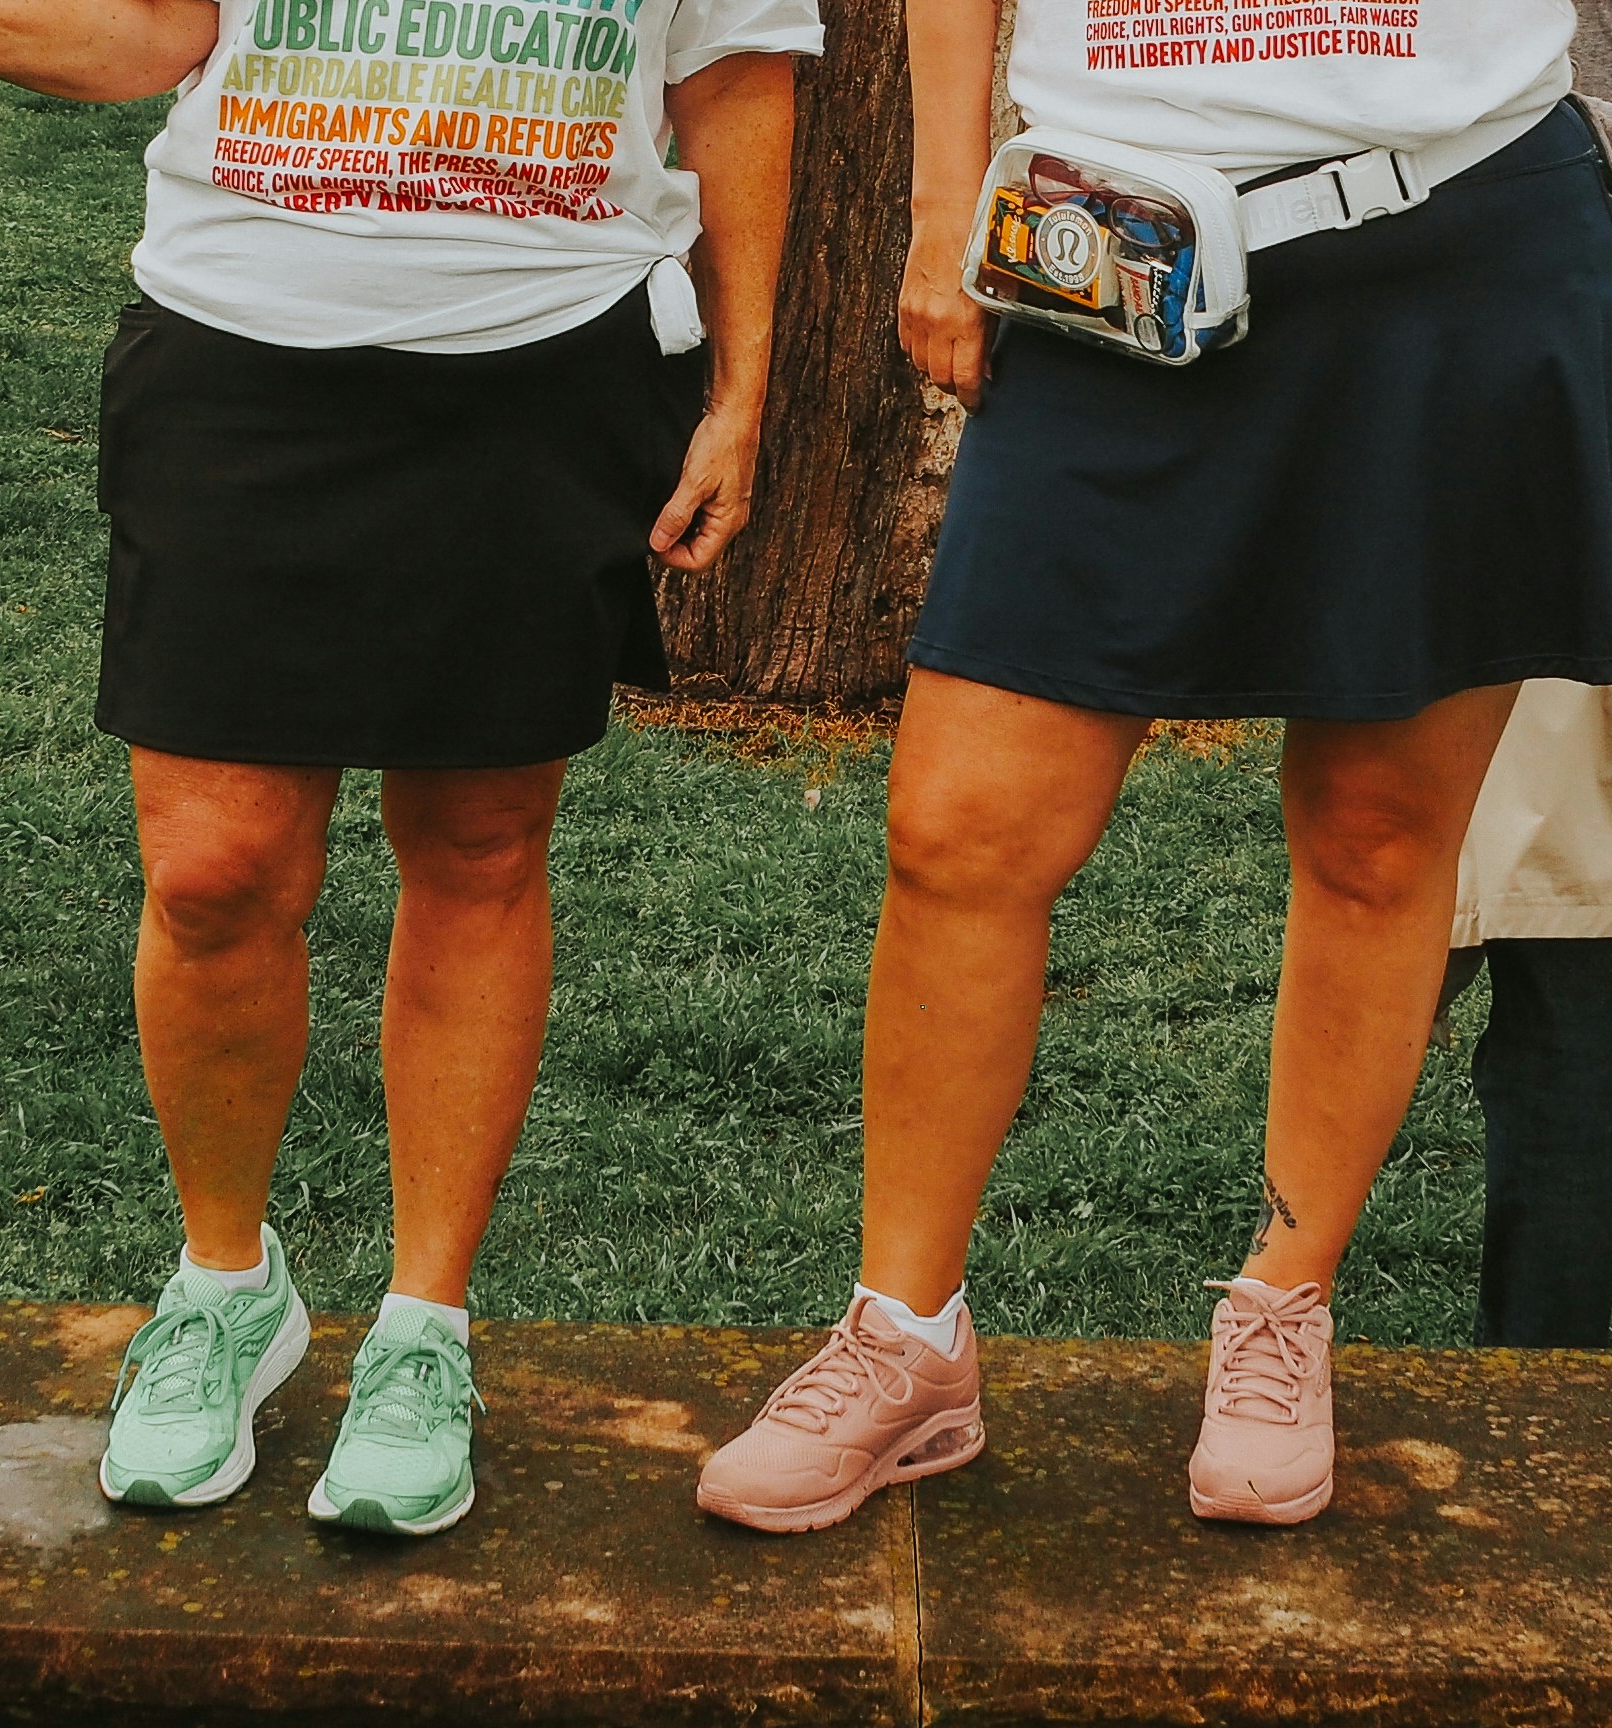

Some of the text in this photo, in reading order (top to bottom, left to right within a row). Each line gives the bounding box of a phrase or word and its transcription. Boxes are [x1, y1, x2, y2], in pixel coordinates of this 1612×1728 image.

[396, 0, 636, 83] EDUCATION
[1086, 6, 1418, 41] CHOICE, CIVIL RIGHTS, GUN CONTROL, FAIR WAGES
[1087, 29, 1416, 70] WITH LIBERTY AND JUSTICE FOR ALL
[222, 53, 627, 119] AFFORDABLE HEALTH CARE
[220, 94, 407, 145] IMMIGRANTS
[411, 108, 480, 151] AND
[212, 166, 268, 197] CHOICE,
[272, 173, 320, 191] CIVIL
[397, 179, 436, 198] GUN
[438, 176, 522, 198] CONTROL,
[214, 138, 292, 167] FREEDOM
[292, 146, 314, 168] OF
[317, 148, 393, 178] SPEECH,
[398, 152, 431, 175] THE
[433, 153, 501, 178] PRESS,
[505, 162, 547, 185] AND
[1048, 210, 1094, 236] lululemon
